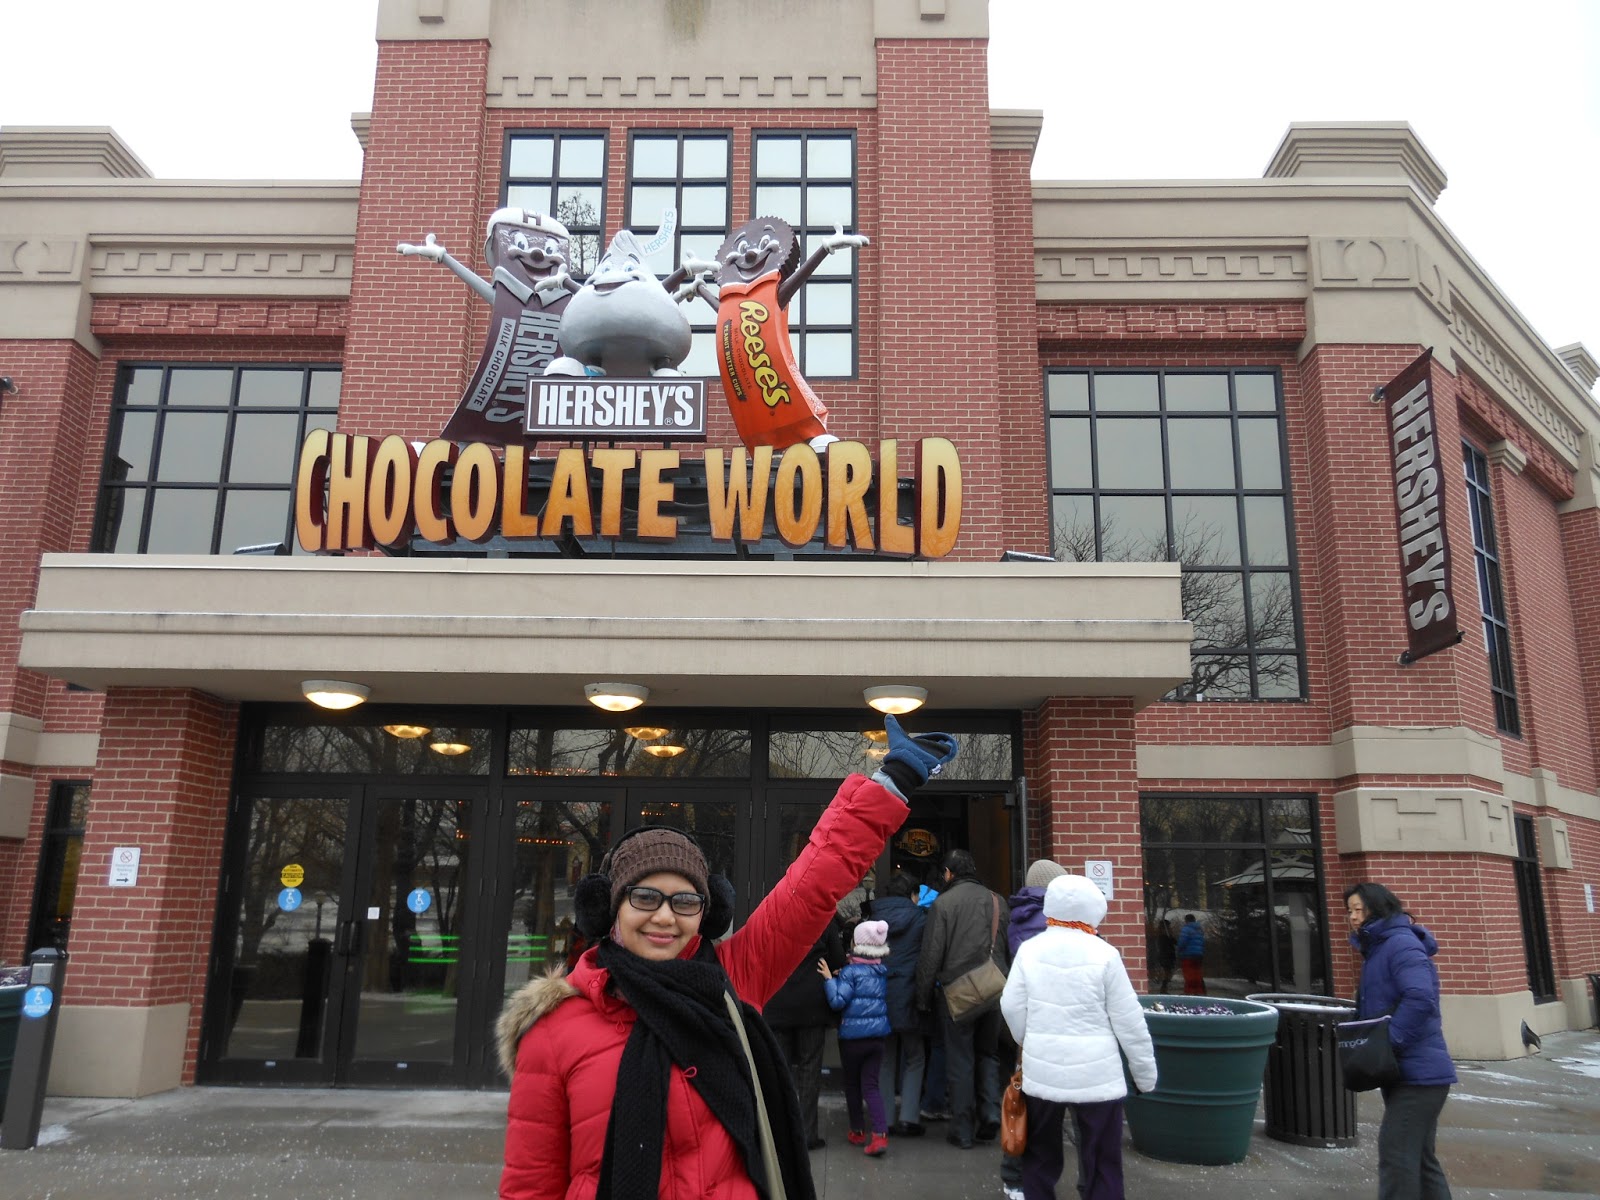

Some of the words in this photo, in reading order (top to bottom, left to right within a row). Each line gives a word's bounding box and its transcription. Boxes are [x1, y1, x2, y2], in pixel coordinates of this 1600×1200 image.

[499, 322, 513, 348] MILK
[738, 300, 791, 408] Reese's
[473, 350, 505, 407] CHOCOLATE
[725, 351, 735, 377] BUTTER
[732, 378, 742, 397] CUPS
[537, 384, 694, 426] HERSHEY'S
[295, 427, 678, 553] CHOCOLATE
[704, 437, 963, 559] WORLD
[1391, 379, 1450, 631] HERSHEY'S
